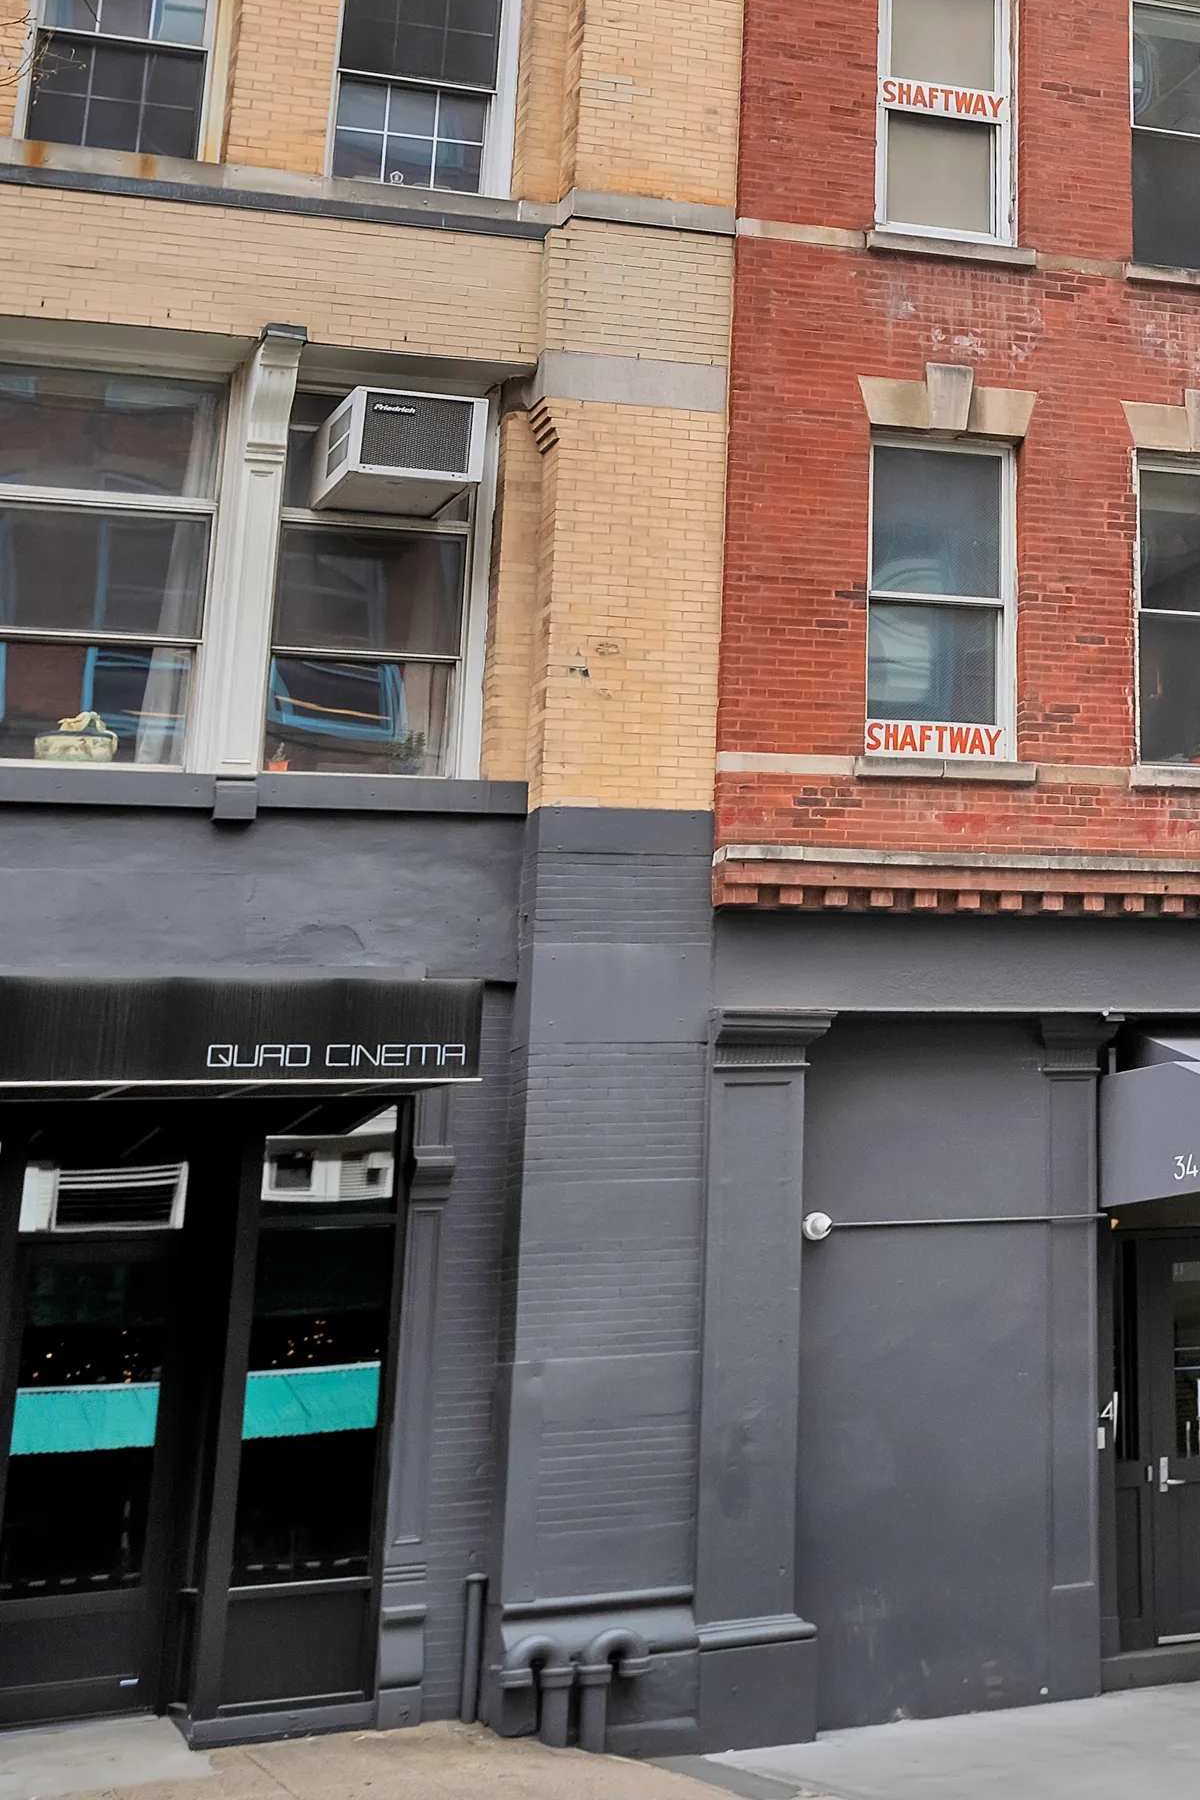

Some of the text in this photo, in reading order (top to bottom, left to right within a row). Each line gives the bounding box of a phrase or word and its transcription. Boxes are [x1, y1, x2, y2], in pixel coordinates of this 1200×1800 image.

[883, 80, 1005, 118] SHAFTWAY
[373, 403, 416, 414] Friedrich
[866, 722, 1003, 756] SHAFTWAY
[207, 1044, 466, 1067] QUAD CINEMA
[1173, 1153, 1199, 1180] 34
